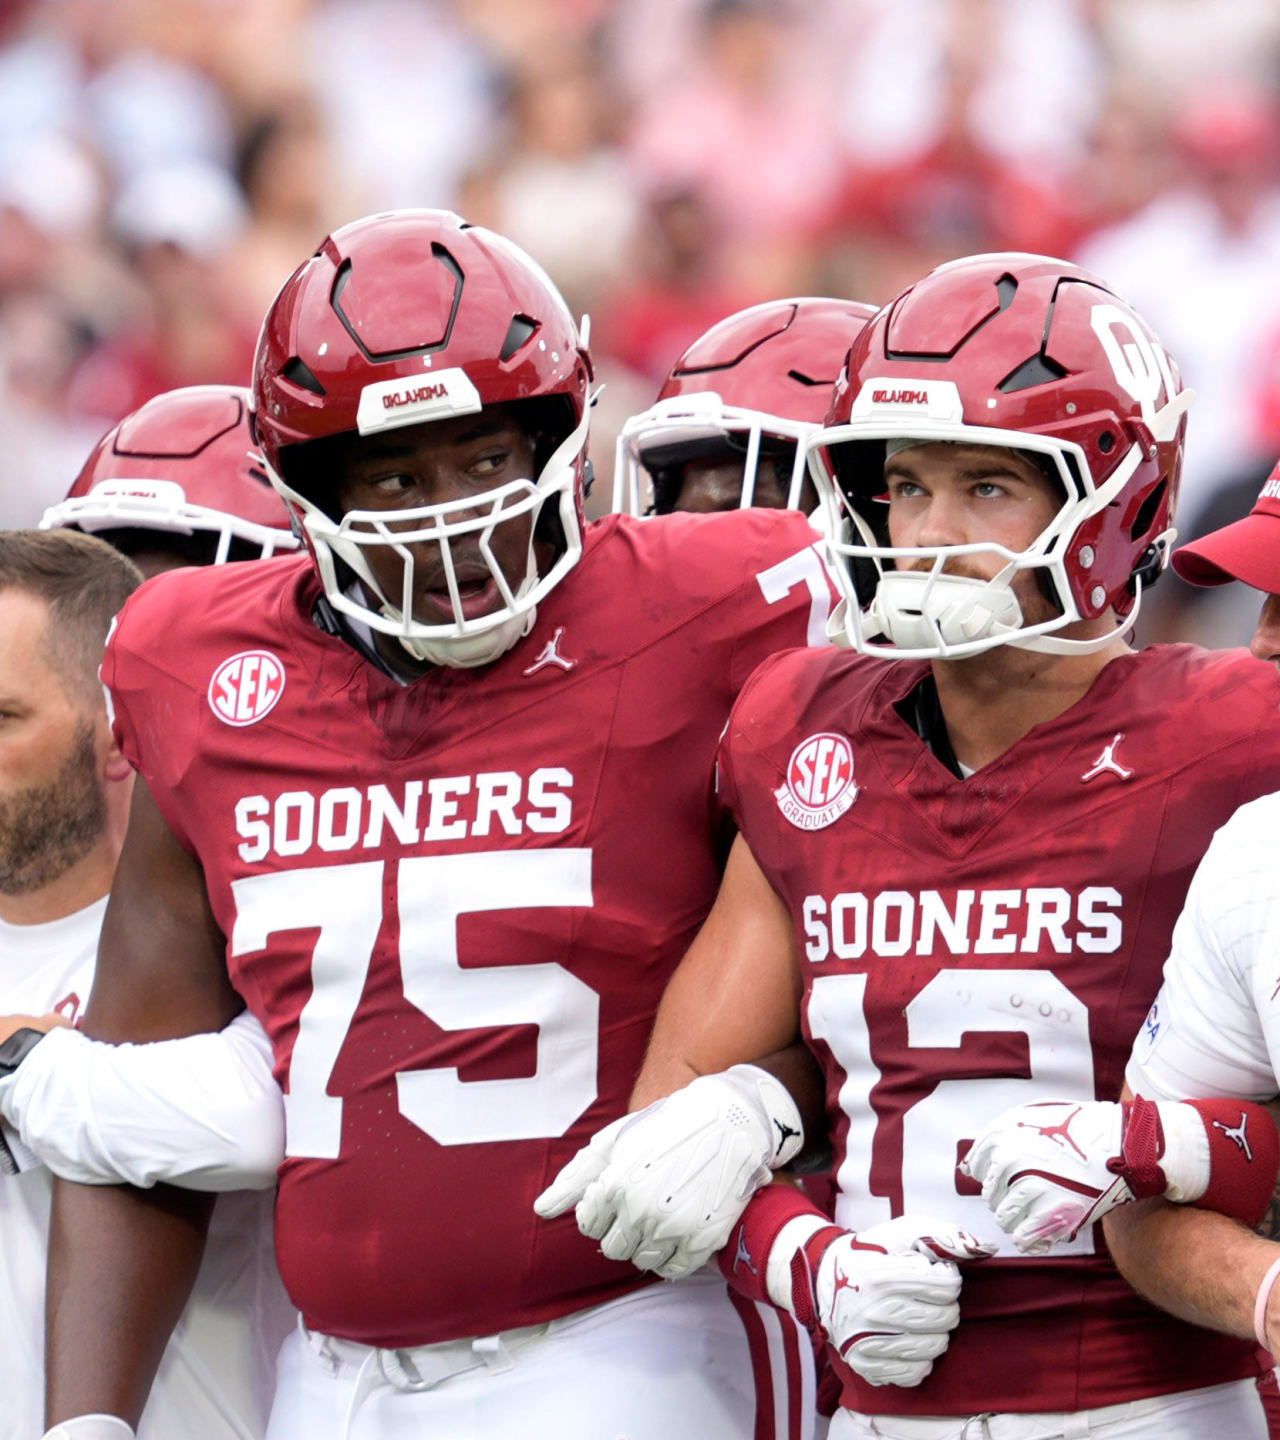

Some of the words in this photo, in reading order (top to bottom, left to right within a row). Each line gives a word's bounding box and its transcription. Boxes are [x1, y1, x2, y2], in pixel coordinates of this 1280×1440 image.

[382, 382, 449, 408] OKLAHOMA
[872, 390, 929, 405] OKLAHOMA
[211, 655, 282, 722] SEC
[794, 738, 849, 804] SEC
[234, 767, 574, 862] SOONERS
[783, 800, 847, 828] GRADUATE
[803, 886, 1123, 962] SOONERS
[230, 848, 600, 1160] 75
[806, 969, 1096, 1257] 12
